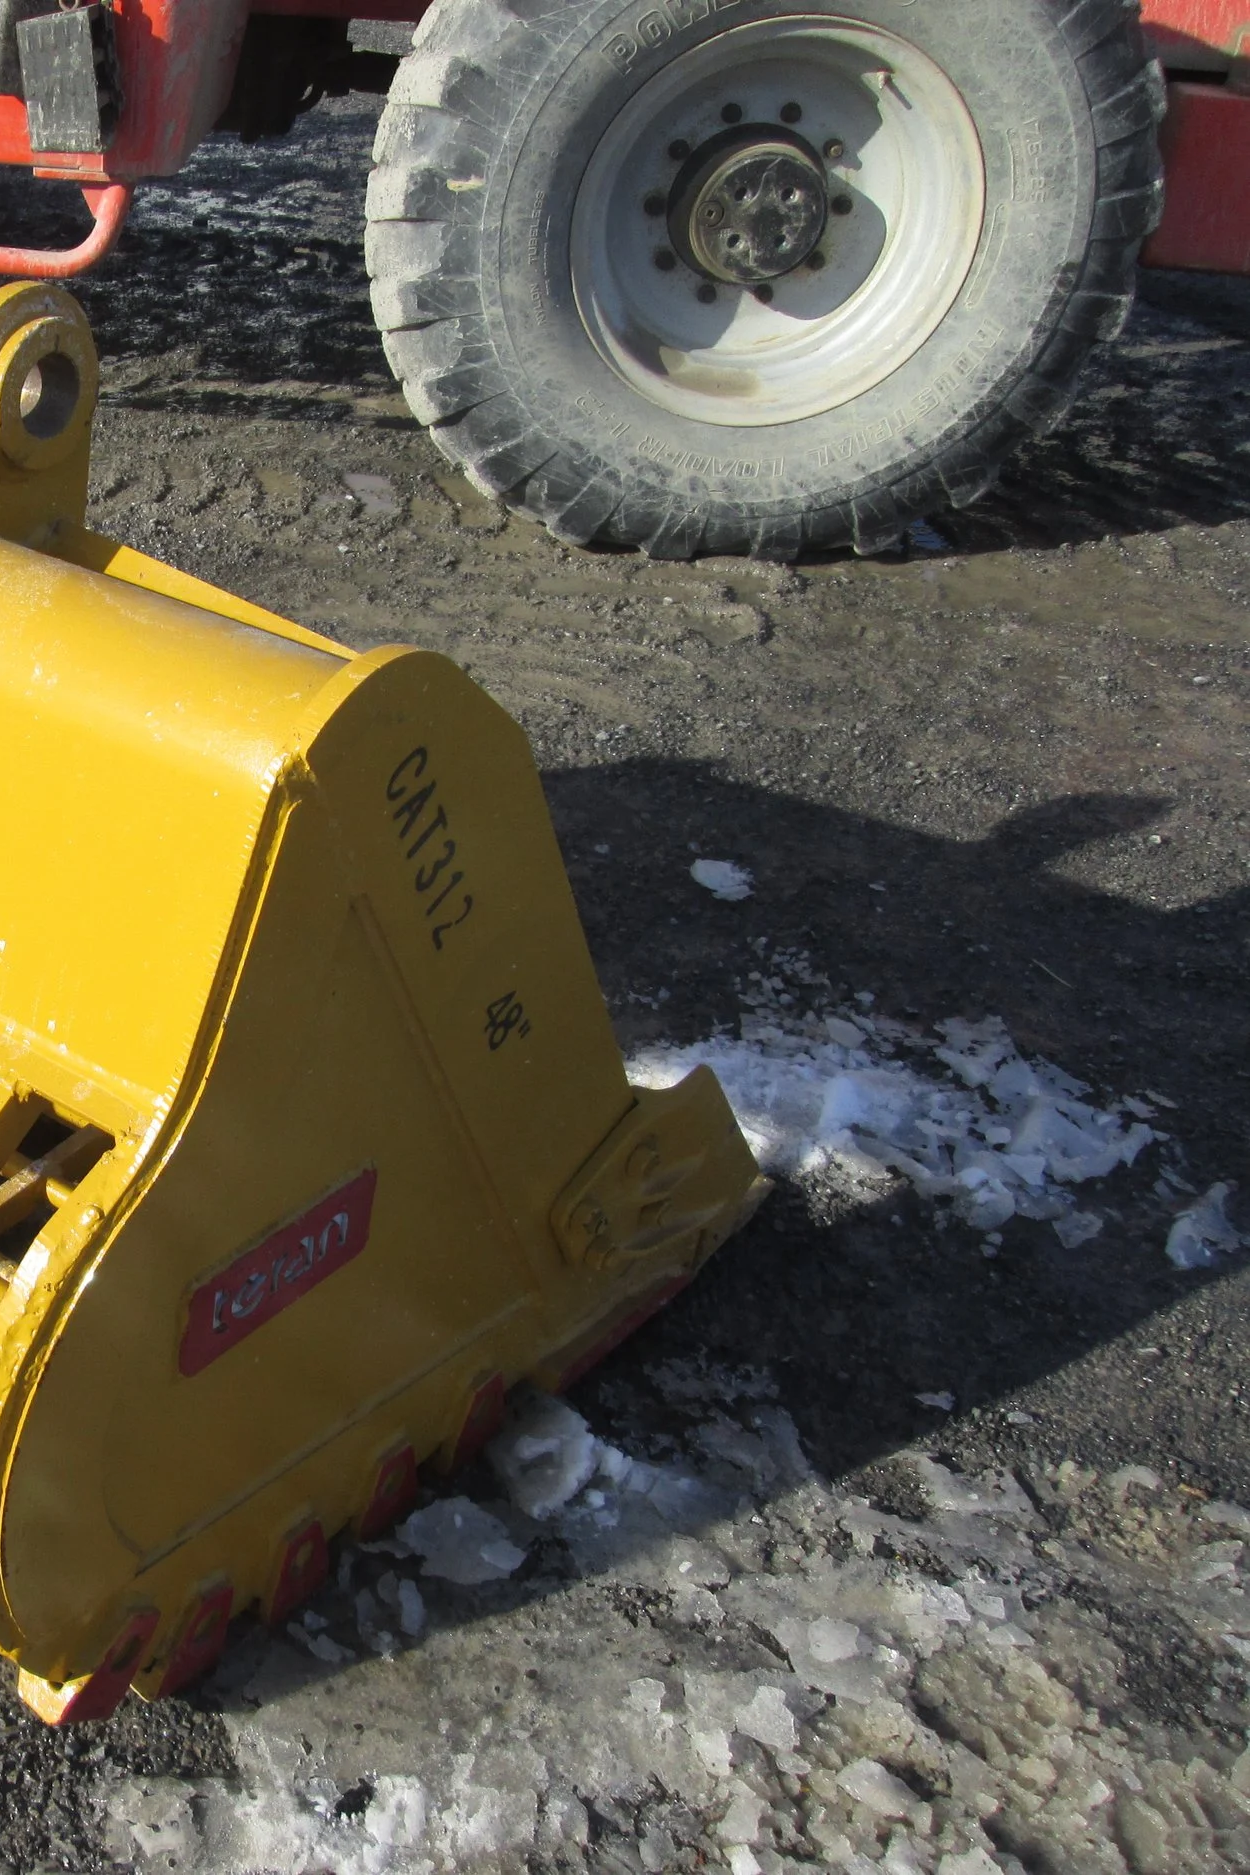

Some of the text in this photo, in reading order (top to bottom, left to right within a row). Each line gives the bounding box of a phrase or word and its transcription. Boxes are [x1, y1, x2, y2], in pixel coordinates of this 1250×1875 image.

[528, 190, 547, 326] NYLON TUBELESS
[637, 436, 785, 479] LOADER
[806, 317, 1005, 468] INDUSTRIAL
[386, 746, 473, 950] CAT312
